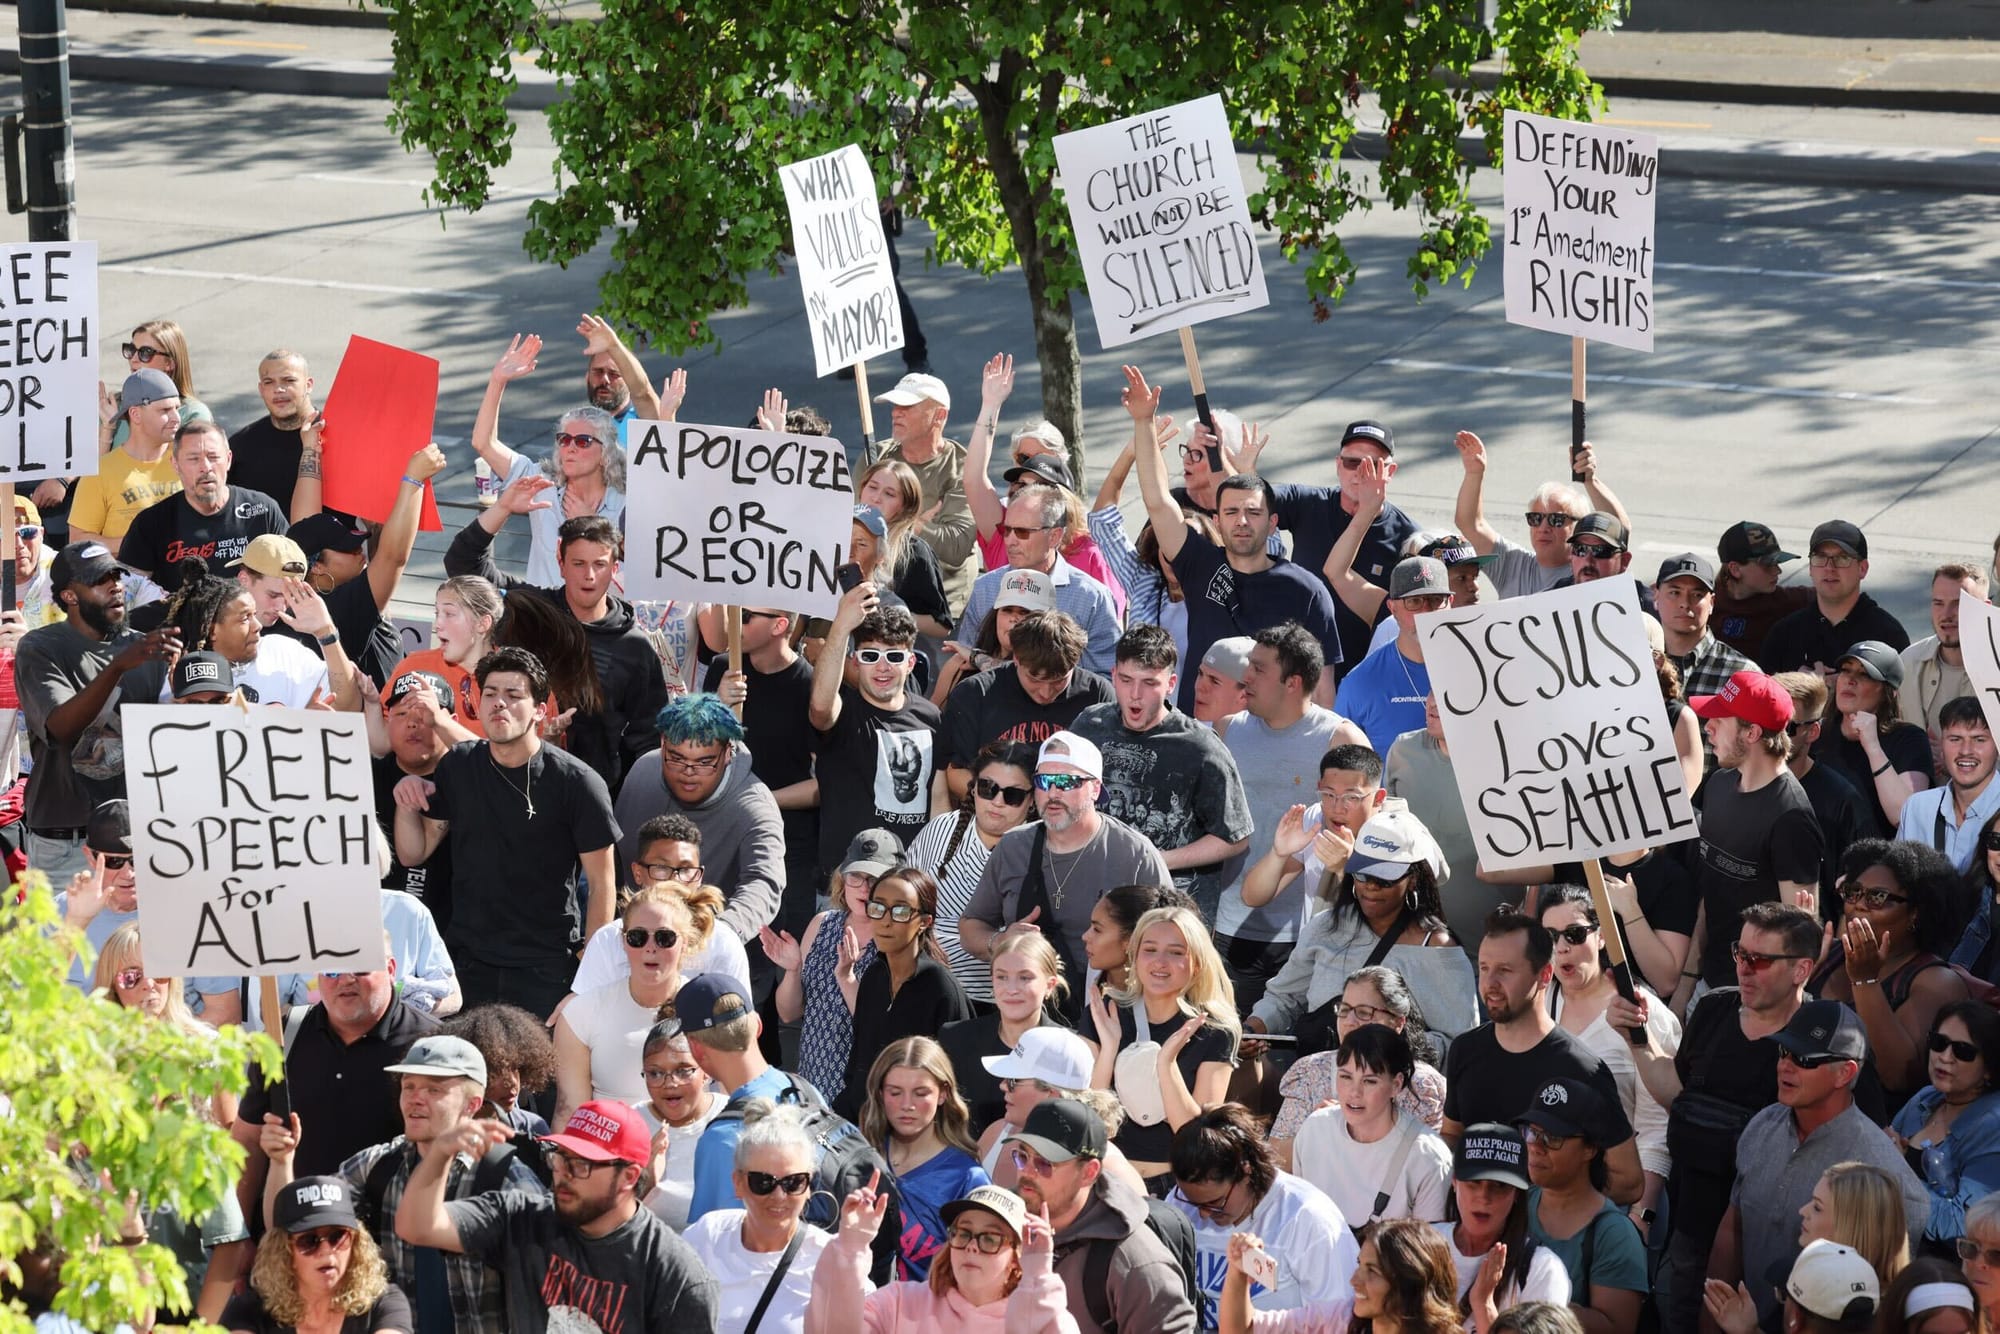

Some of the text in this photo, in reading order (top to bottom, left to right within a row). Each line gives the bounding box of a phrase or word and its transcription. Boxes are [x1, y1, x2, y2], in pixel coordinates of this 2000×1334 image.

[1125, 115, 1177, 151] THE
[790, 151, 855, 203] WHAT
[1086, 140, 1215, 212] CHURCH
[1544, 169, 1620, 218] YOUR
[804, 197, 883, 270] VALUES
[1098, 186, 1234, 245] WILL NOT BE
[1103, 220, 1255, 319] SILENCED
[1534, 211, 1652, 278] Amedment
[0, 251, 72, 309] EE
[0, 317, 88, 369] EECH
[822, 286, 898, 366] MAYOR?
[0, 376, 46, 417] OR
[633, 424, 853, 492] APOLOGIZE
[709, 501, 788, 534] OR
[215, 545, 250, 559] OFF DRU
[655, 525, 842, 595] RESIGN
[188, 662, 215, 679] JESUS
[1429, 599, 1642, 717] JESUS
[1029, 721, 1050, 743] NO
[142, 720, 359, 813] FREE
[147, 814, 370, 878] SPEECH
[217, 876, 286, 914] for
[187, 900, 361, 969] ALL
[583, 1124, 614, 1143] AGAIN
[585, 1109, 621, 1133] PRAYER
[1465, 1137, 1521, 1154] MAKE PRAYER
[1465, 1149, 1519, 1165] GREAT AGAIN
[296, 1183, 342, 1205] FIND GOD
[540, 1253, 629, 1334] REVIVAL
